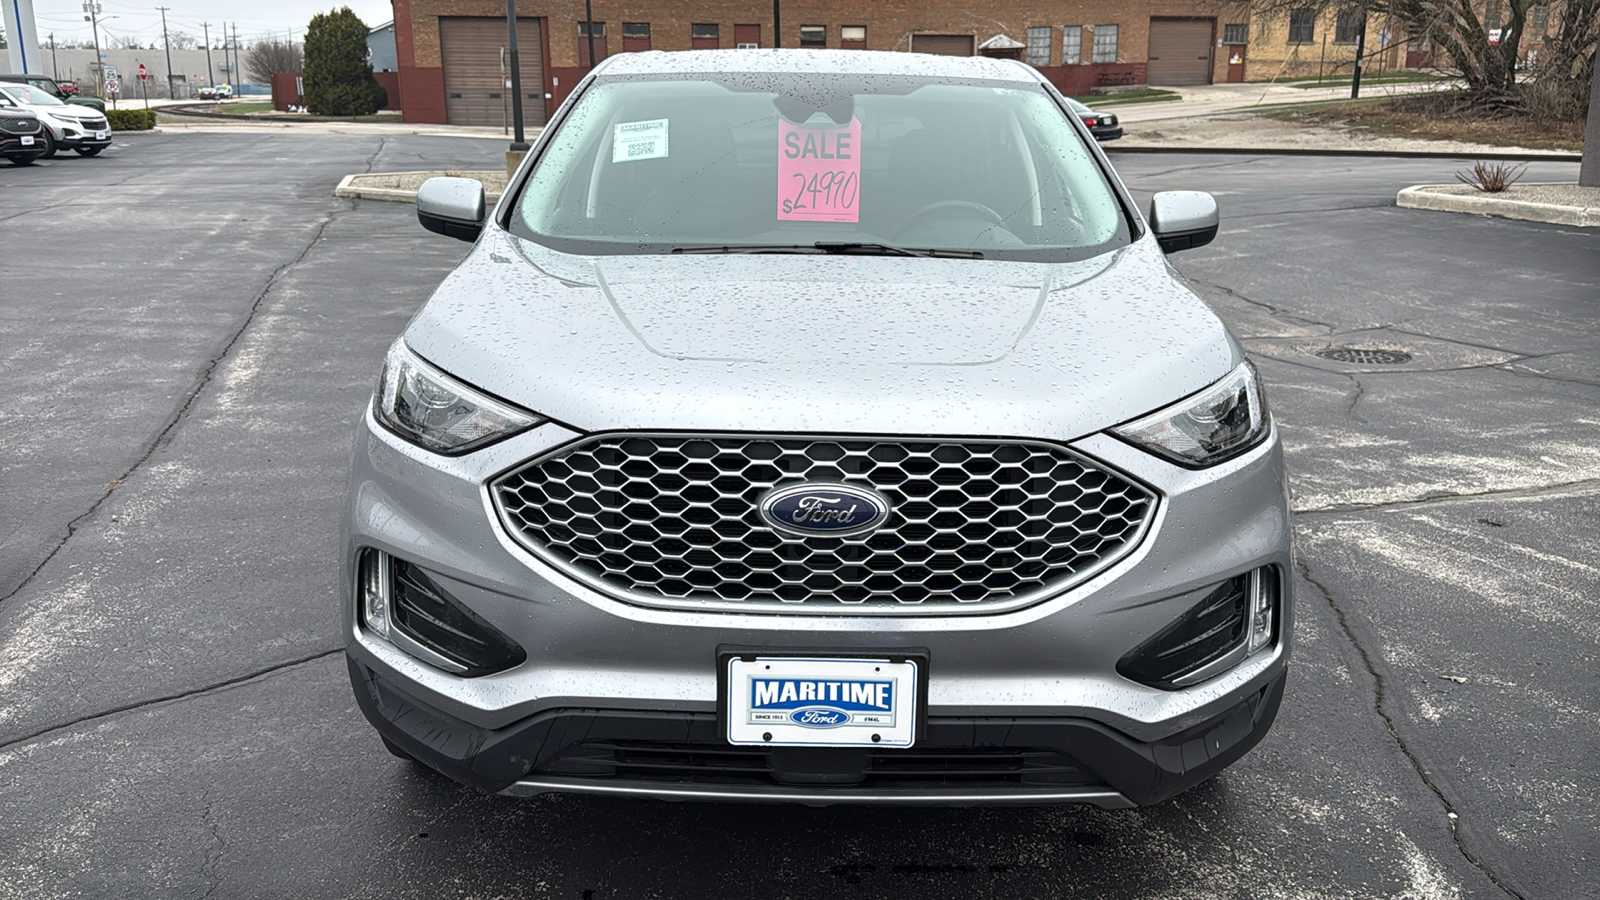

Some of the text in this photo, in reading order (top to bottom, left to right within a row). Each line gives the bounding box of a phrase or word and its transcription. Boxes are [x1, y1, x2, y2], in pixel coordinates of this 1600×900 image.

[784, 131, 851, 159] SALE
[792, 496, 857, 523] Ford
[755, 681, 889, 709] MARITIME
[801, 711, 839, 724] Ford
